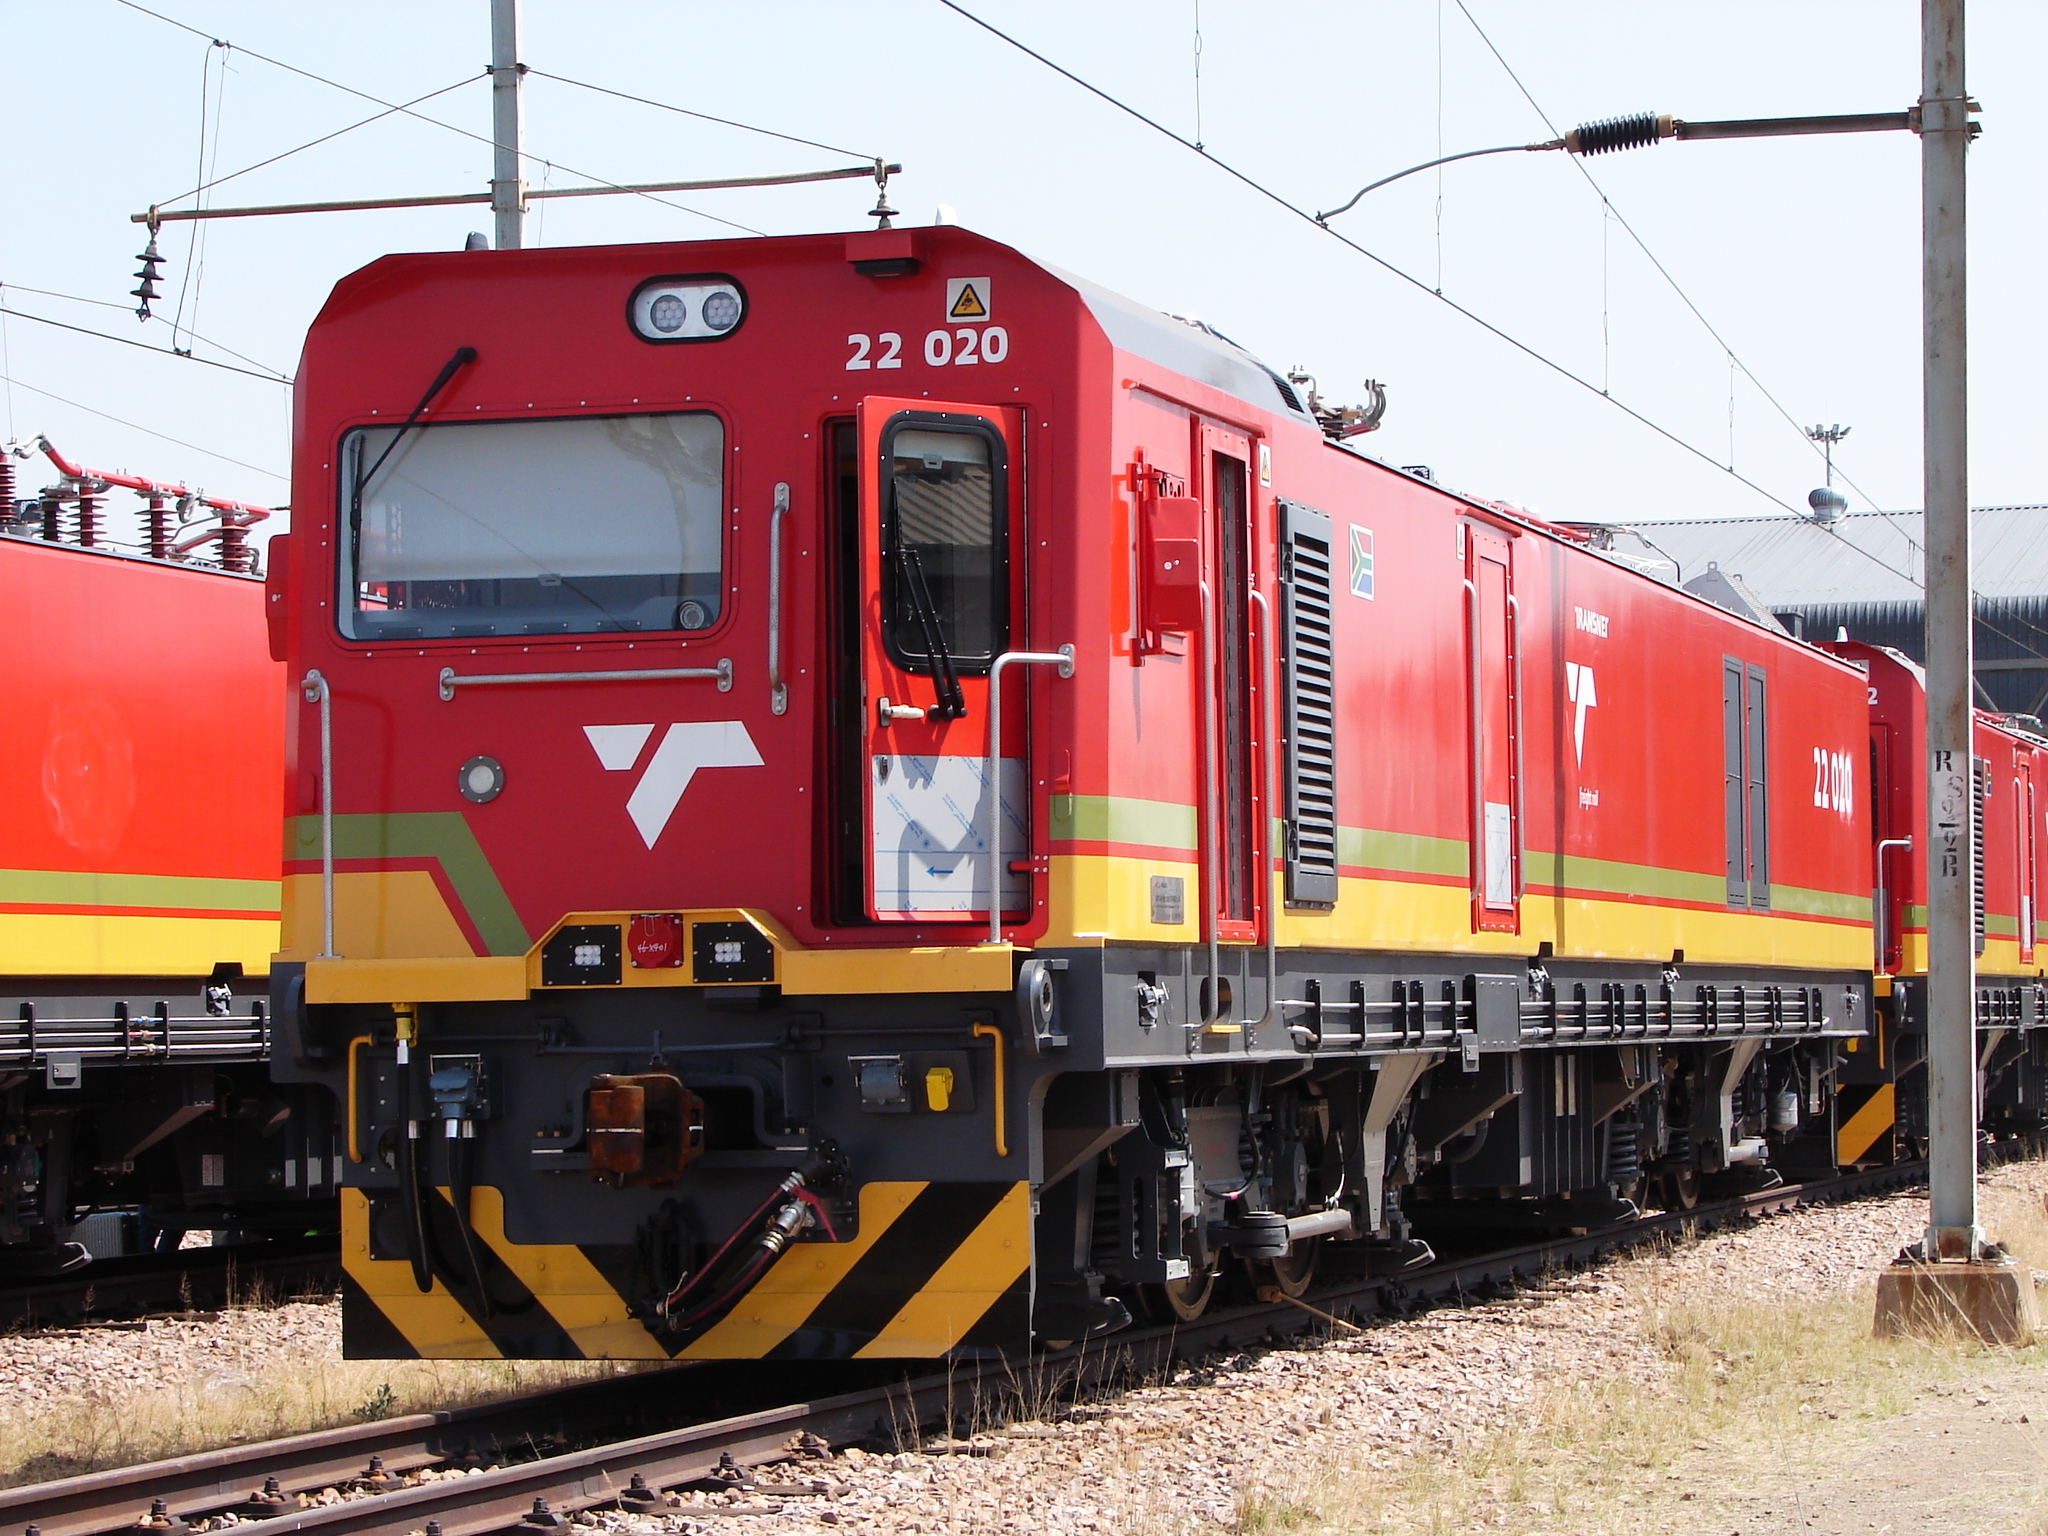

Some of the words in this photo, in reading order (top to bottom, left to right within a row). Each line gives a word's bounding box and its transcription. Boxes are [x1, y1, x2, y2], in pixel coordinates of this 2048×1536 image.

[845, 332, 903, 371] 22
[924, 326, 1009, 367] 020
[1574, 606, 1610, 639] TRANSNET
[1813, 746, 1829, 809] 22
[1831, 752, 1853, 813] 020
